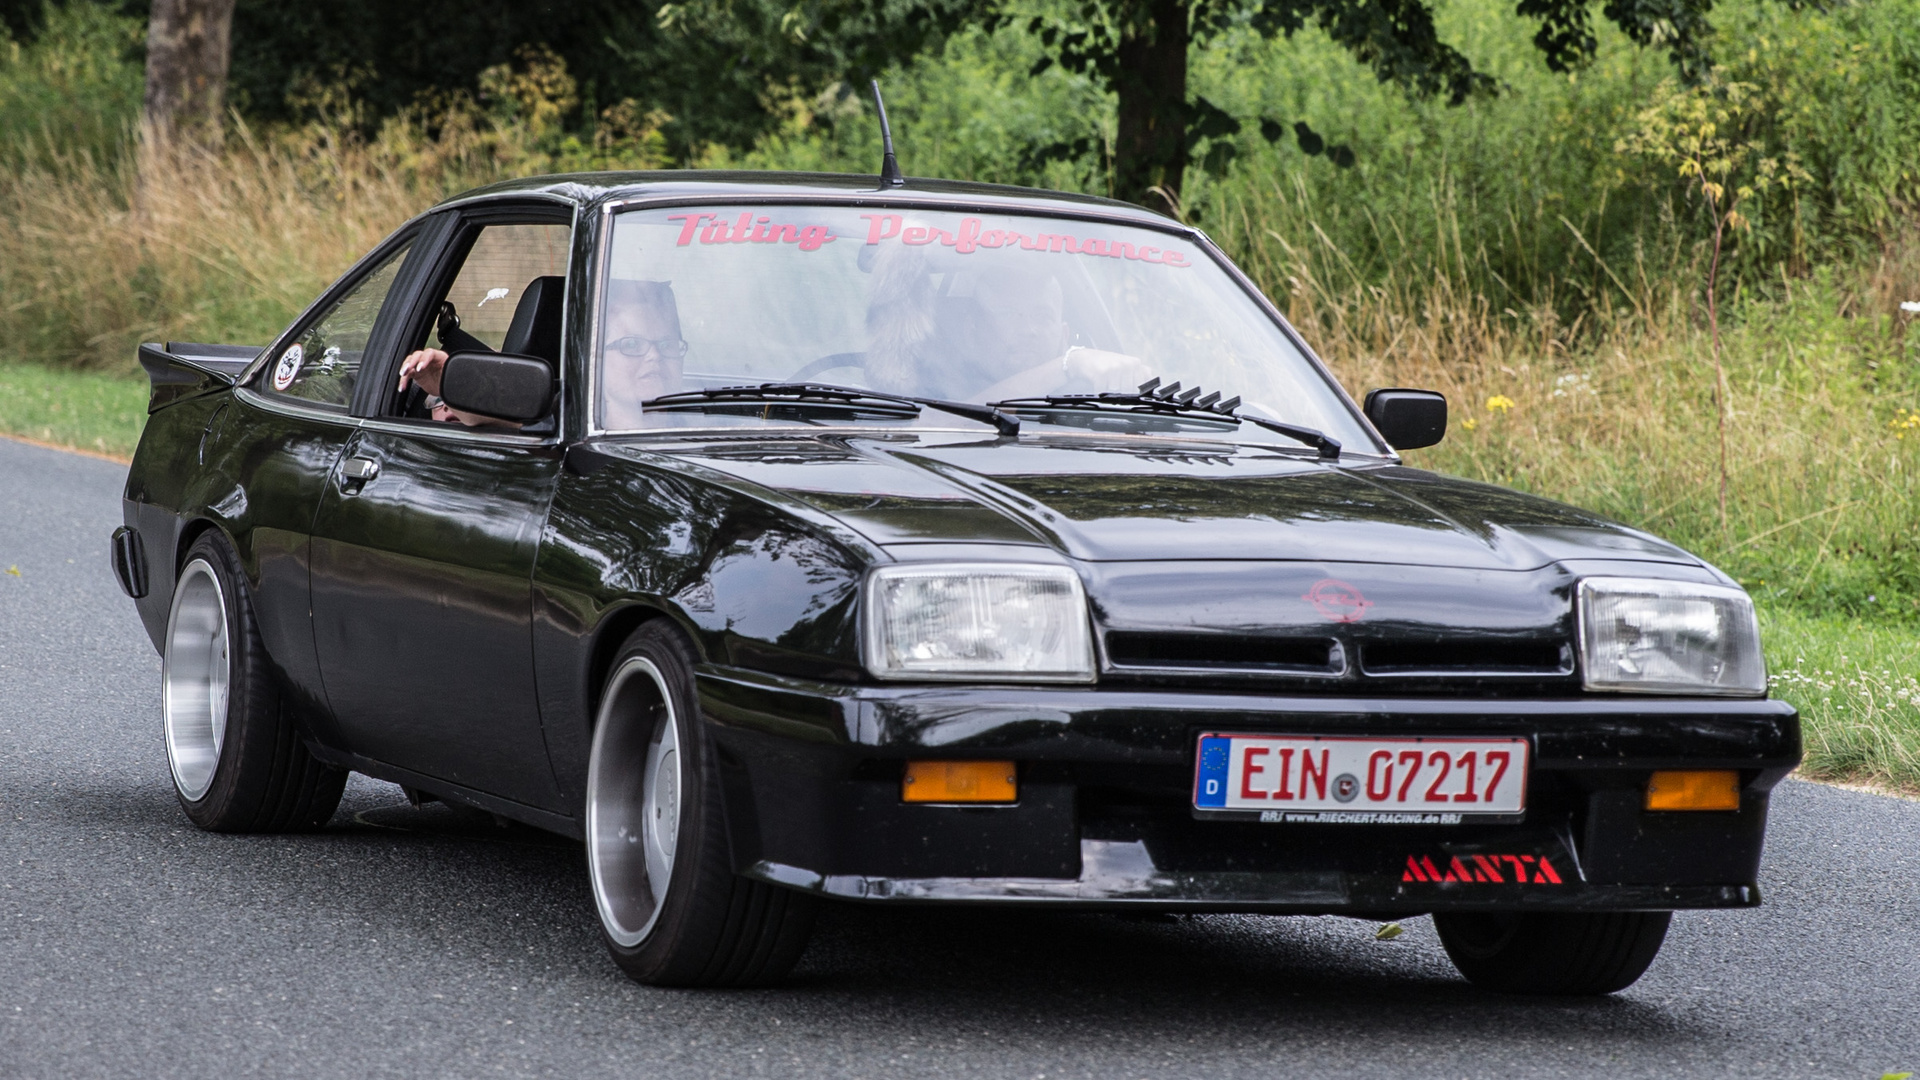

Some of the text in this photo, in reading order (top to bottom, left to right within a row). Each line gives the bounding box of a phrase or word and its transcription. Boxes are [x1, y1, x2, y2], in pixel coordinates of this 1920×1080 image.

[667, 212, 1192, 268] Tüting Performance
[1205, 780, 1219, 795] D
[1240, 747, 1511, 803] EIN 07217
[1286, 811, 1439, 825] www.RIECHERT-RACING.de
[1402, 854, 1562, 884] MANTA
